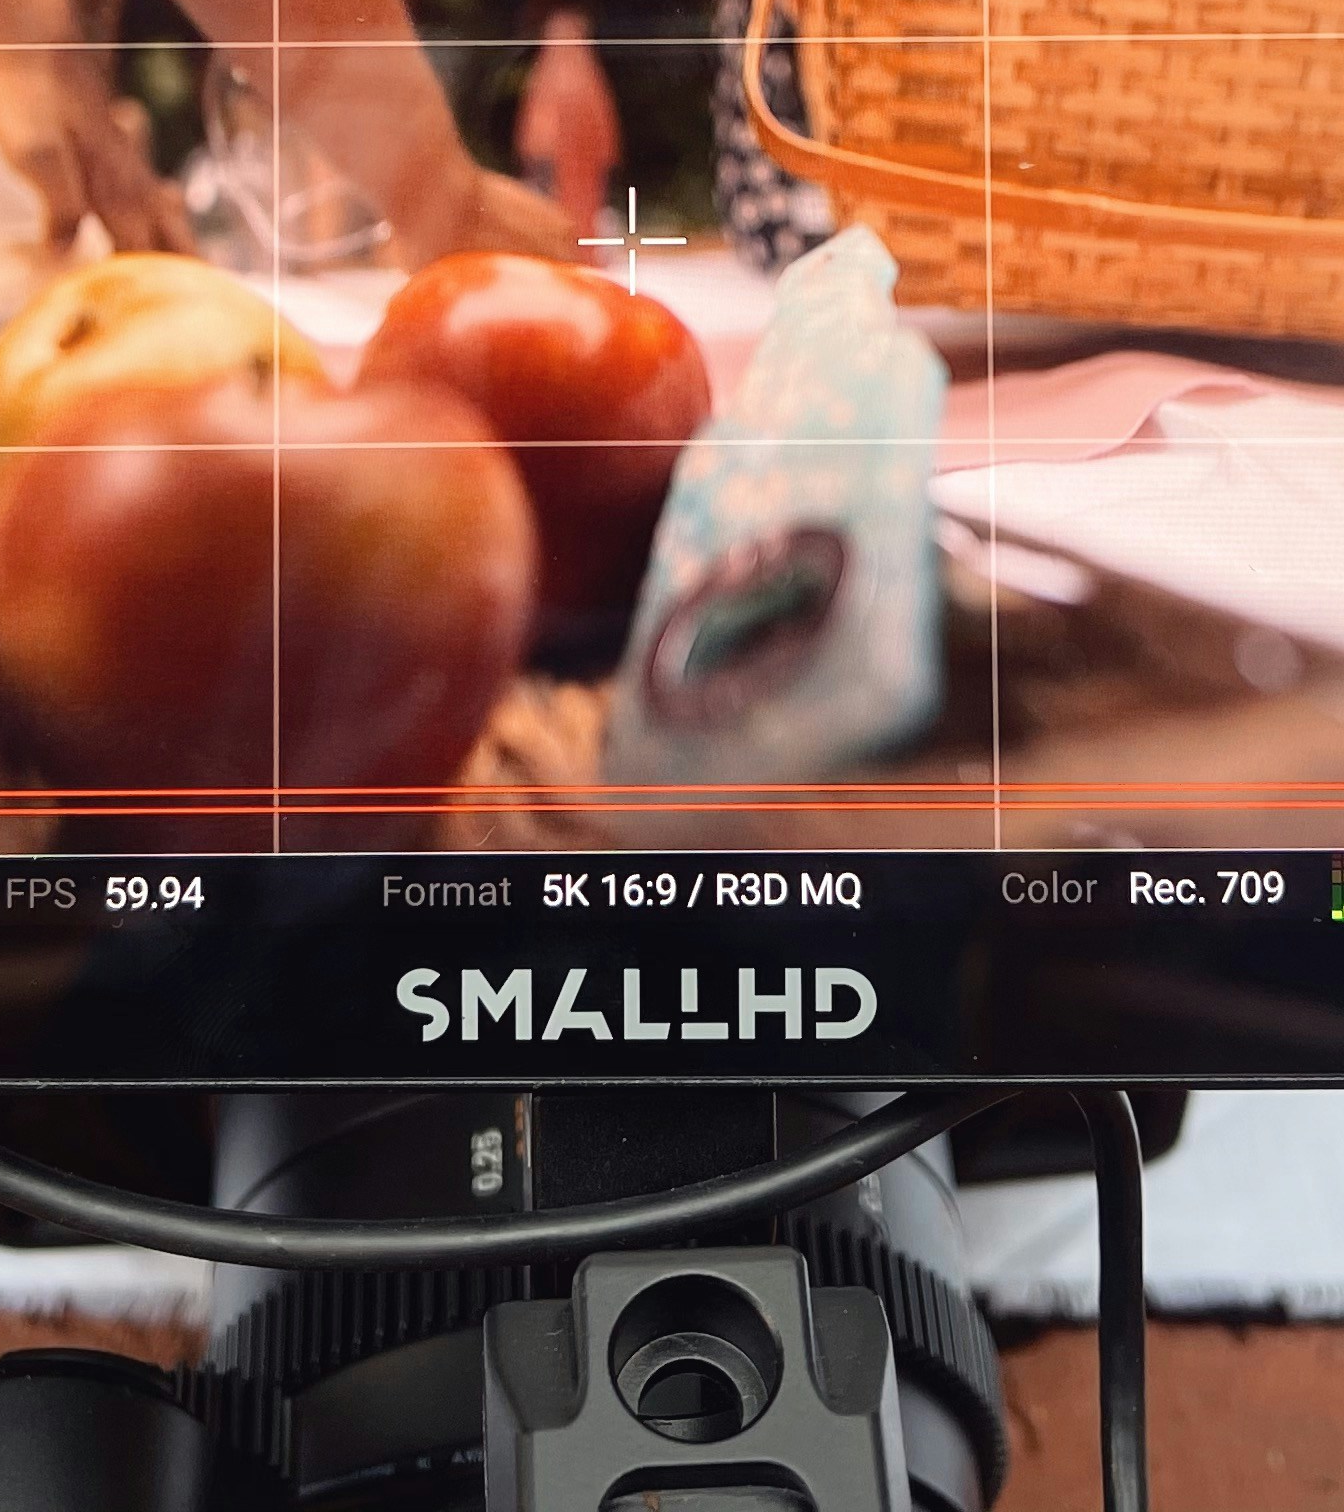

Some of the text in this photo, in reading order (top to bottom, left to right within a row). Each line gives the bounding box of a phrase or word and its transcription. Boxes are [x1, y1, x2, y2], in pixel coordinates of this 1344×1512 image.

[6, 875, 206, 911] FPS 59.94
[382, 873, 863, 910] Format 5K 16:9 / R3D MQ
[1001, 870, 1285, 905] Color Rec. 709
[396, 967, 878, 1042] SMALLHD
